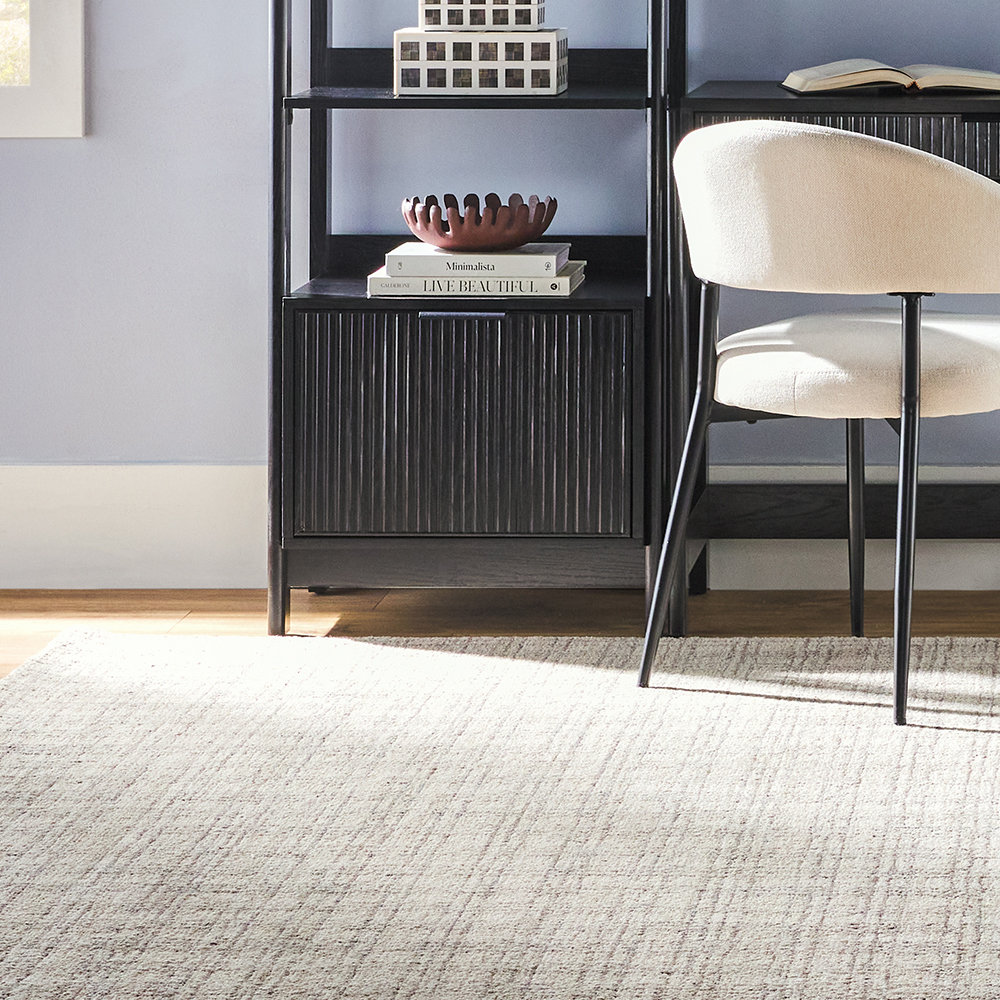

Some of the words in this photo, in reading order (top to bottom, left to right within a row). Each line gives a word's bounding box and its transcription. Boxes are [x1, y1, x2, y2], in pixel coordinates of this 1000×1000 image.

[445, 262, 496, 271] Minimalista
[423, 280, 456, 293] LIVE
[459, 280, 539, 293] BEAUTIFUL
